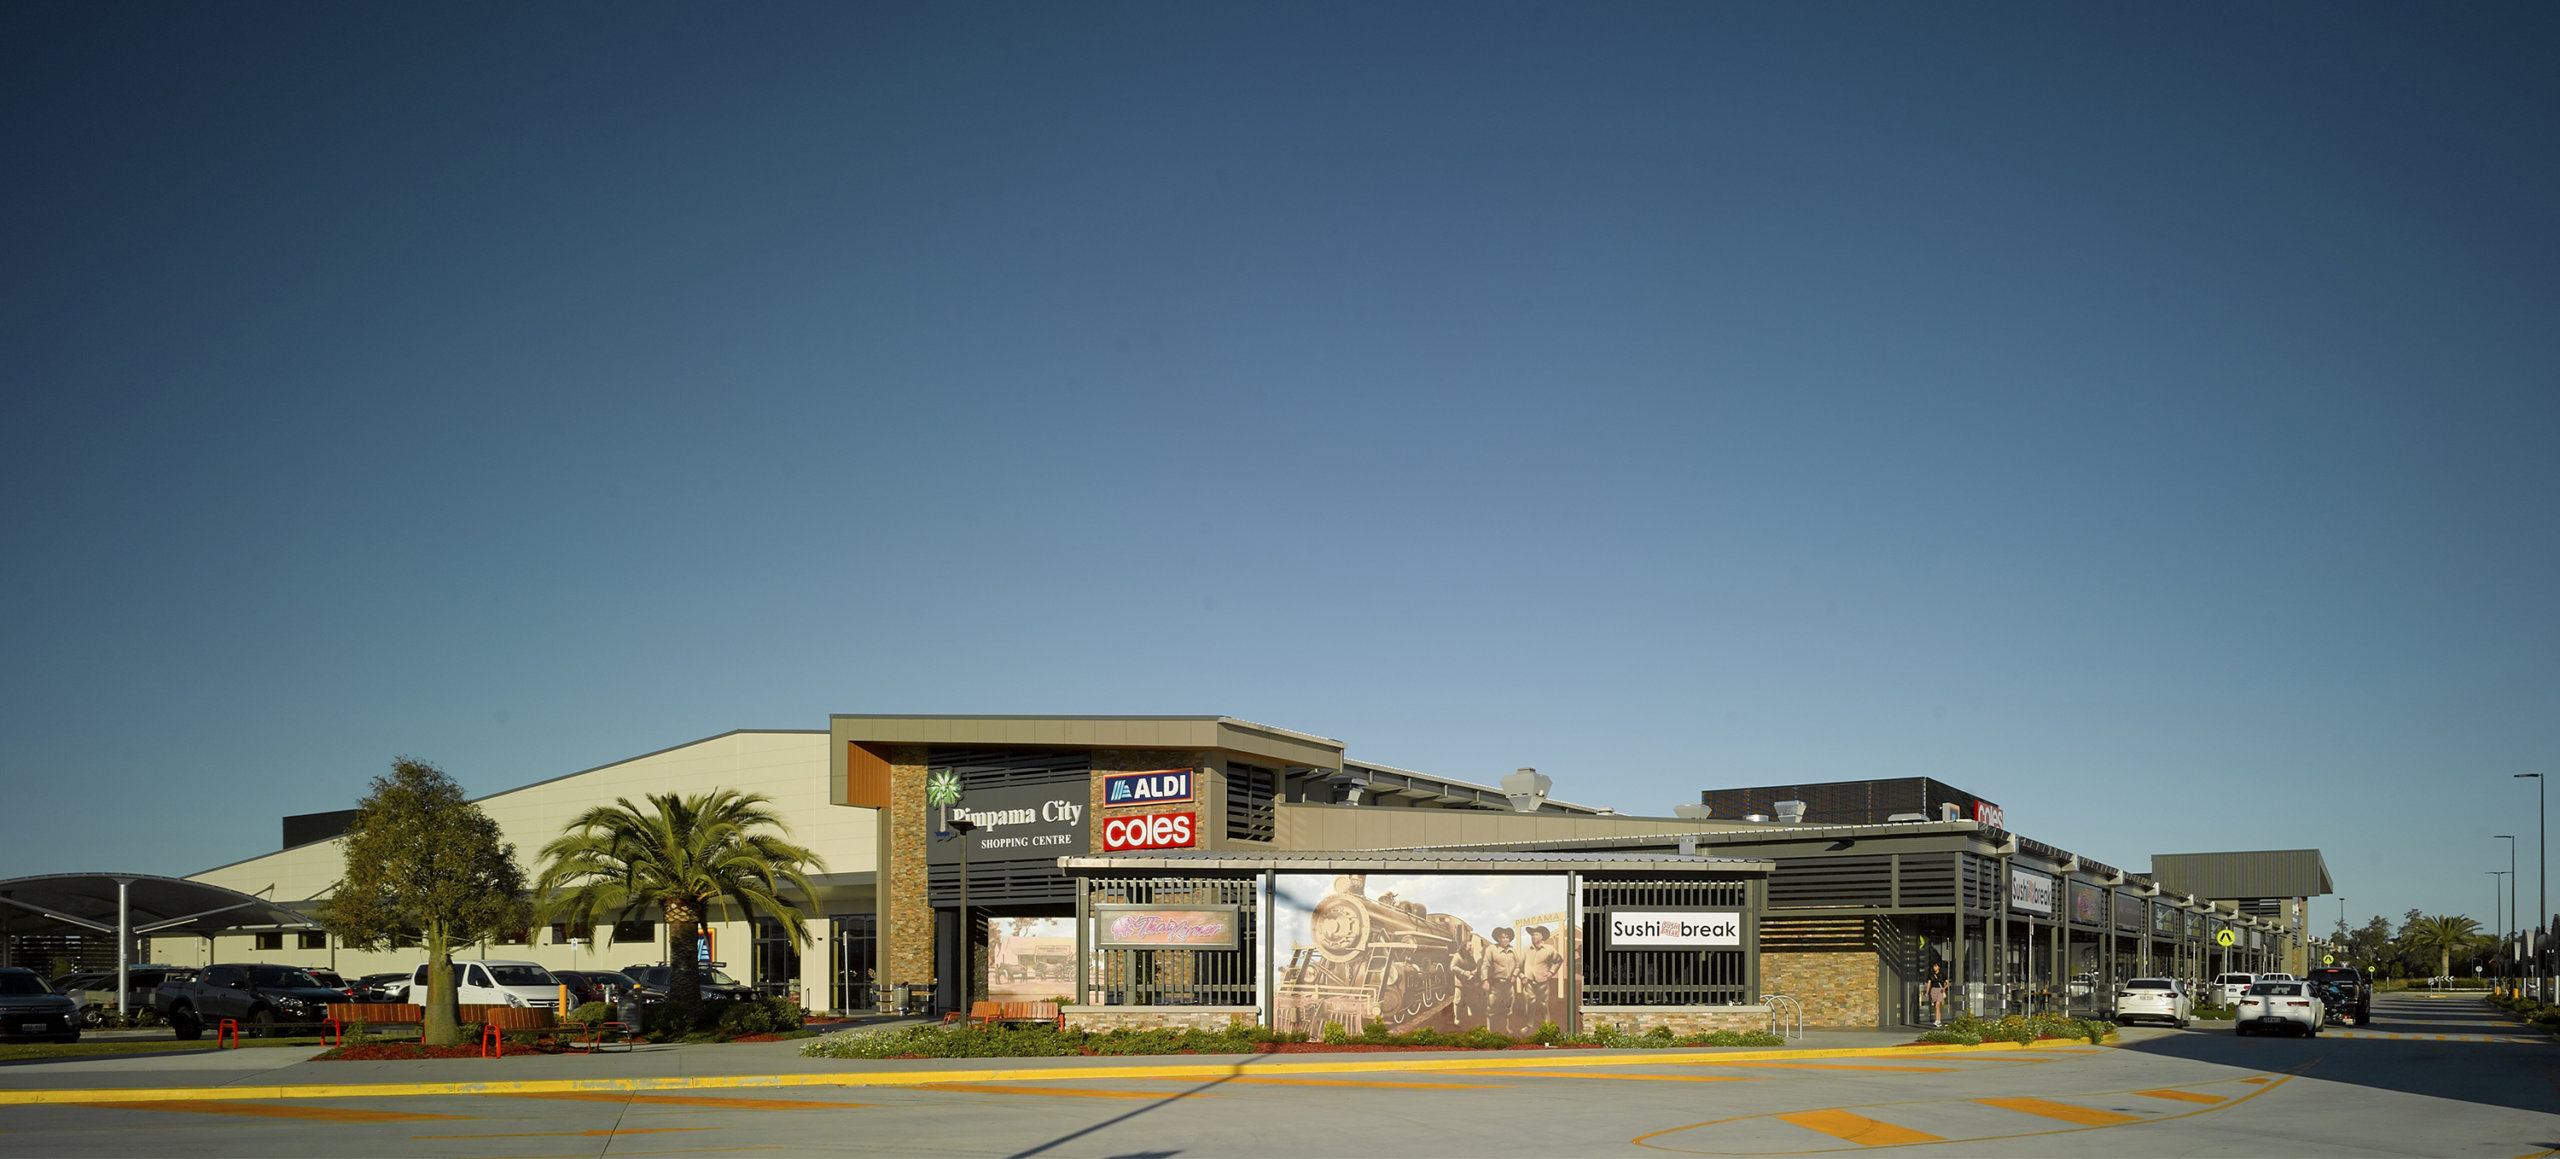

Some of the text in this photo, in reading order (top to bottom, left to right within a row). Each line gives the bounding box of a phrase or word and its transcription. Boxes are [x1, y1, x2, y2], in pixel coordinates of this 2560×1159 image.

[1134, 774, 1186, 799] ALDI
[953, 799, 1083, 832] Pimpama City
[1978, 804, 2004, 830] coles
[981, 834, 1072, 849] SHOPPING CENTRE
[1106, 814, 1190, 847] coles
[1516, 912, 1560, 926] PIMPAMA
[1614, 921, 1736, 937] Sushi break
